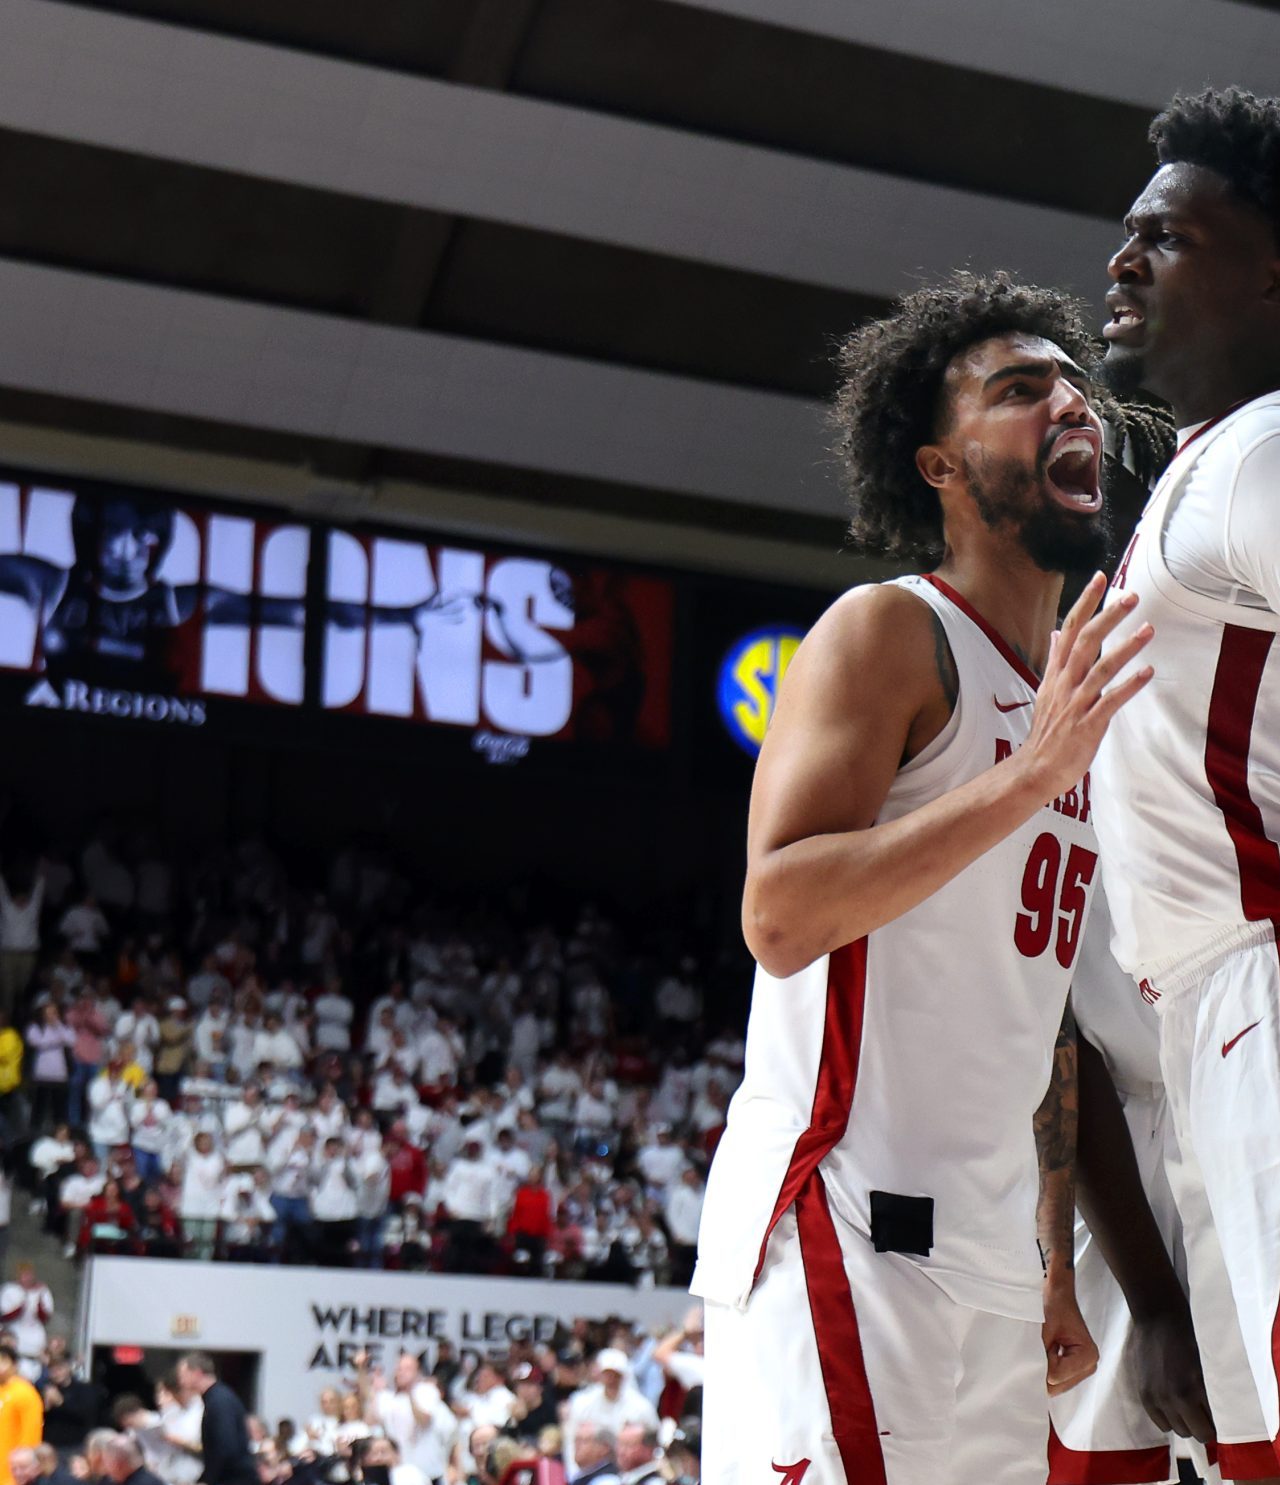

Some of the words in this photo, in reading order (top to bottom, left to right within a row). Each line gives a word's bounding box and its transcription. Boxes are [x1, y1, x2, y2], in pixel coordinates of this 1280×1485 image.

[1013, 831, 1098, 970] 95
[311, 1304, 447, 1338] WHERE
[461, 1311, 570, 1343] LEGE
